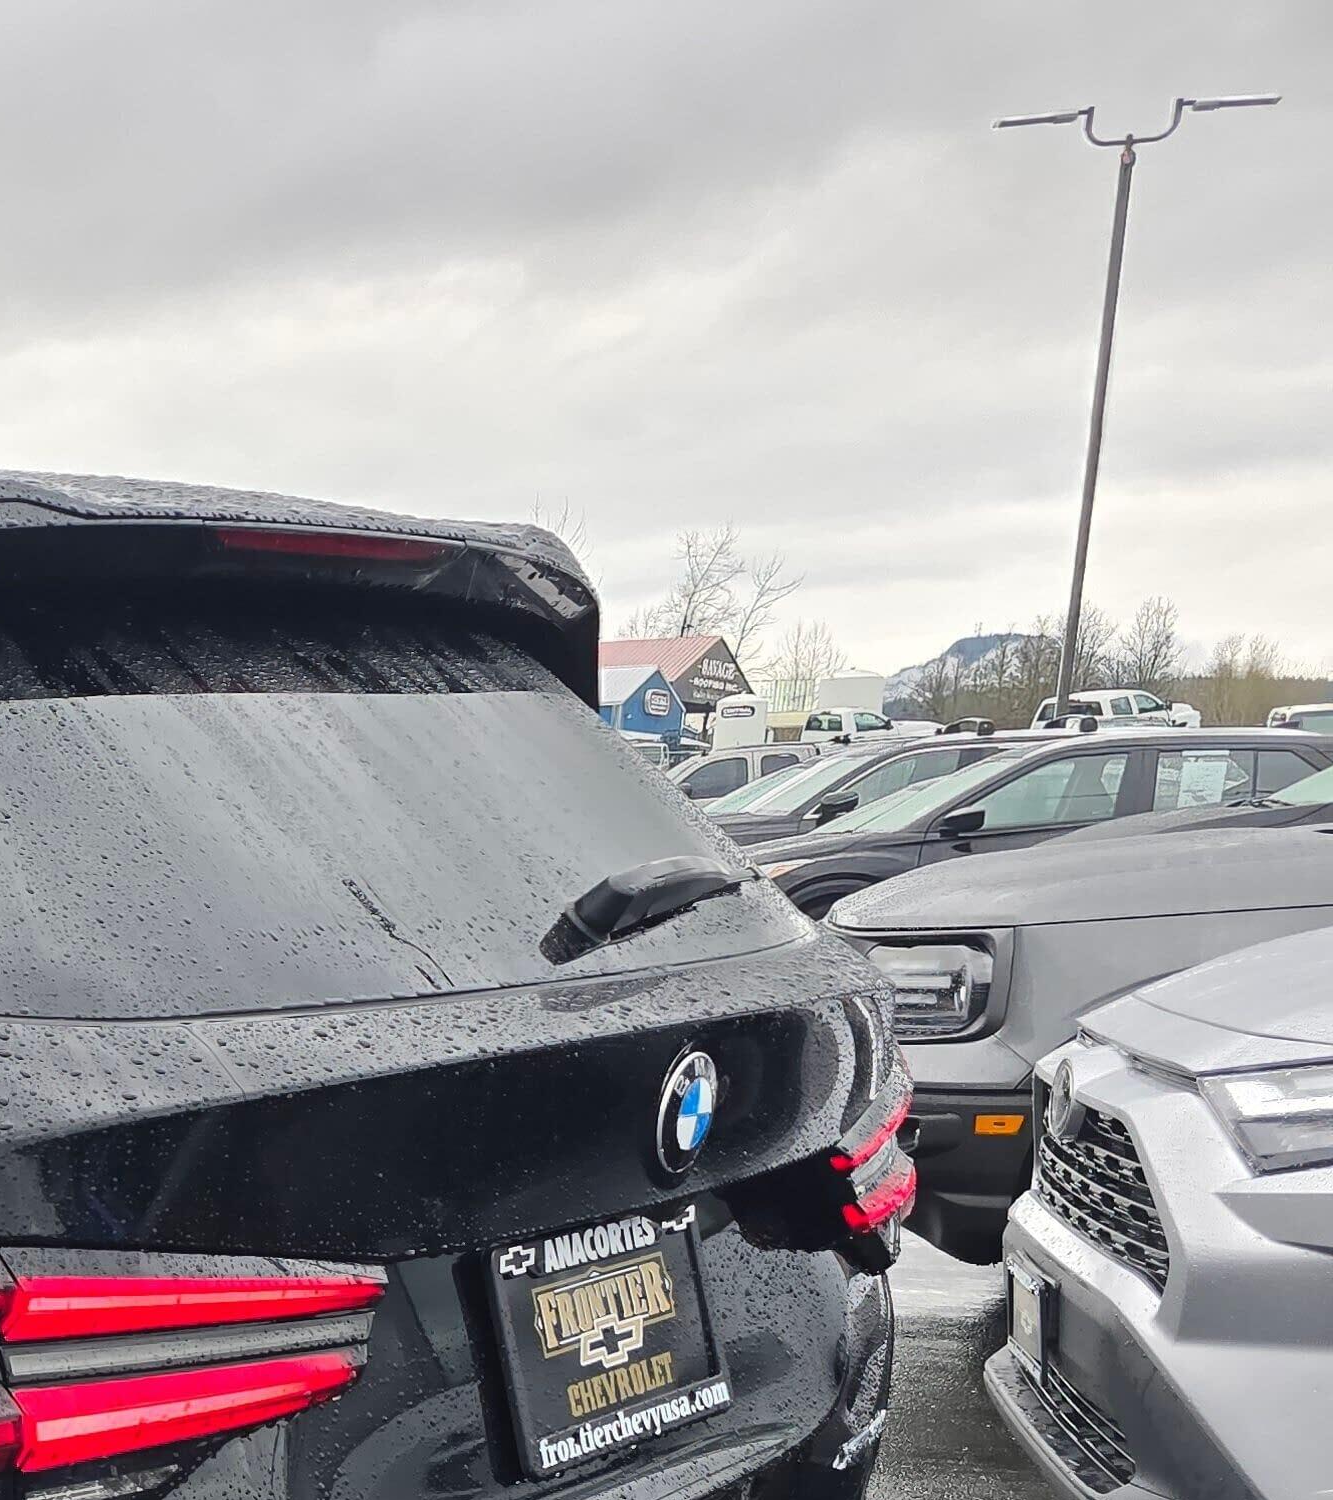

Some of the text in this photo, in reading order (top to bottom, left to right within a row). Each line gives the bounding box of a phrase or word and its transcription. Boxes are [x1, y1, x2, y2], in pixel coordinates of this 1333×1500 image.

[544, 1216, 656, 1273] ANACORTES
[538, 1261, 672, 1349] FRONTIER
[567, 1351, 675, 1417] CHEVROLET
[539, 1382, 730, 1468] frontierchevyusa.com
